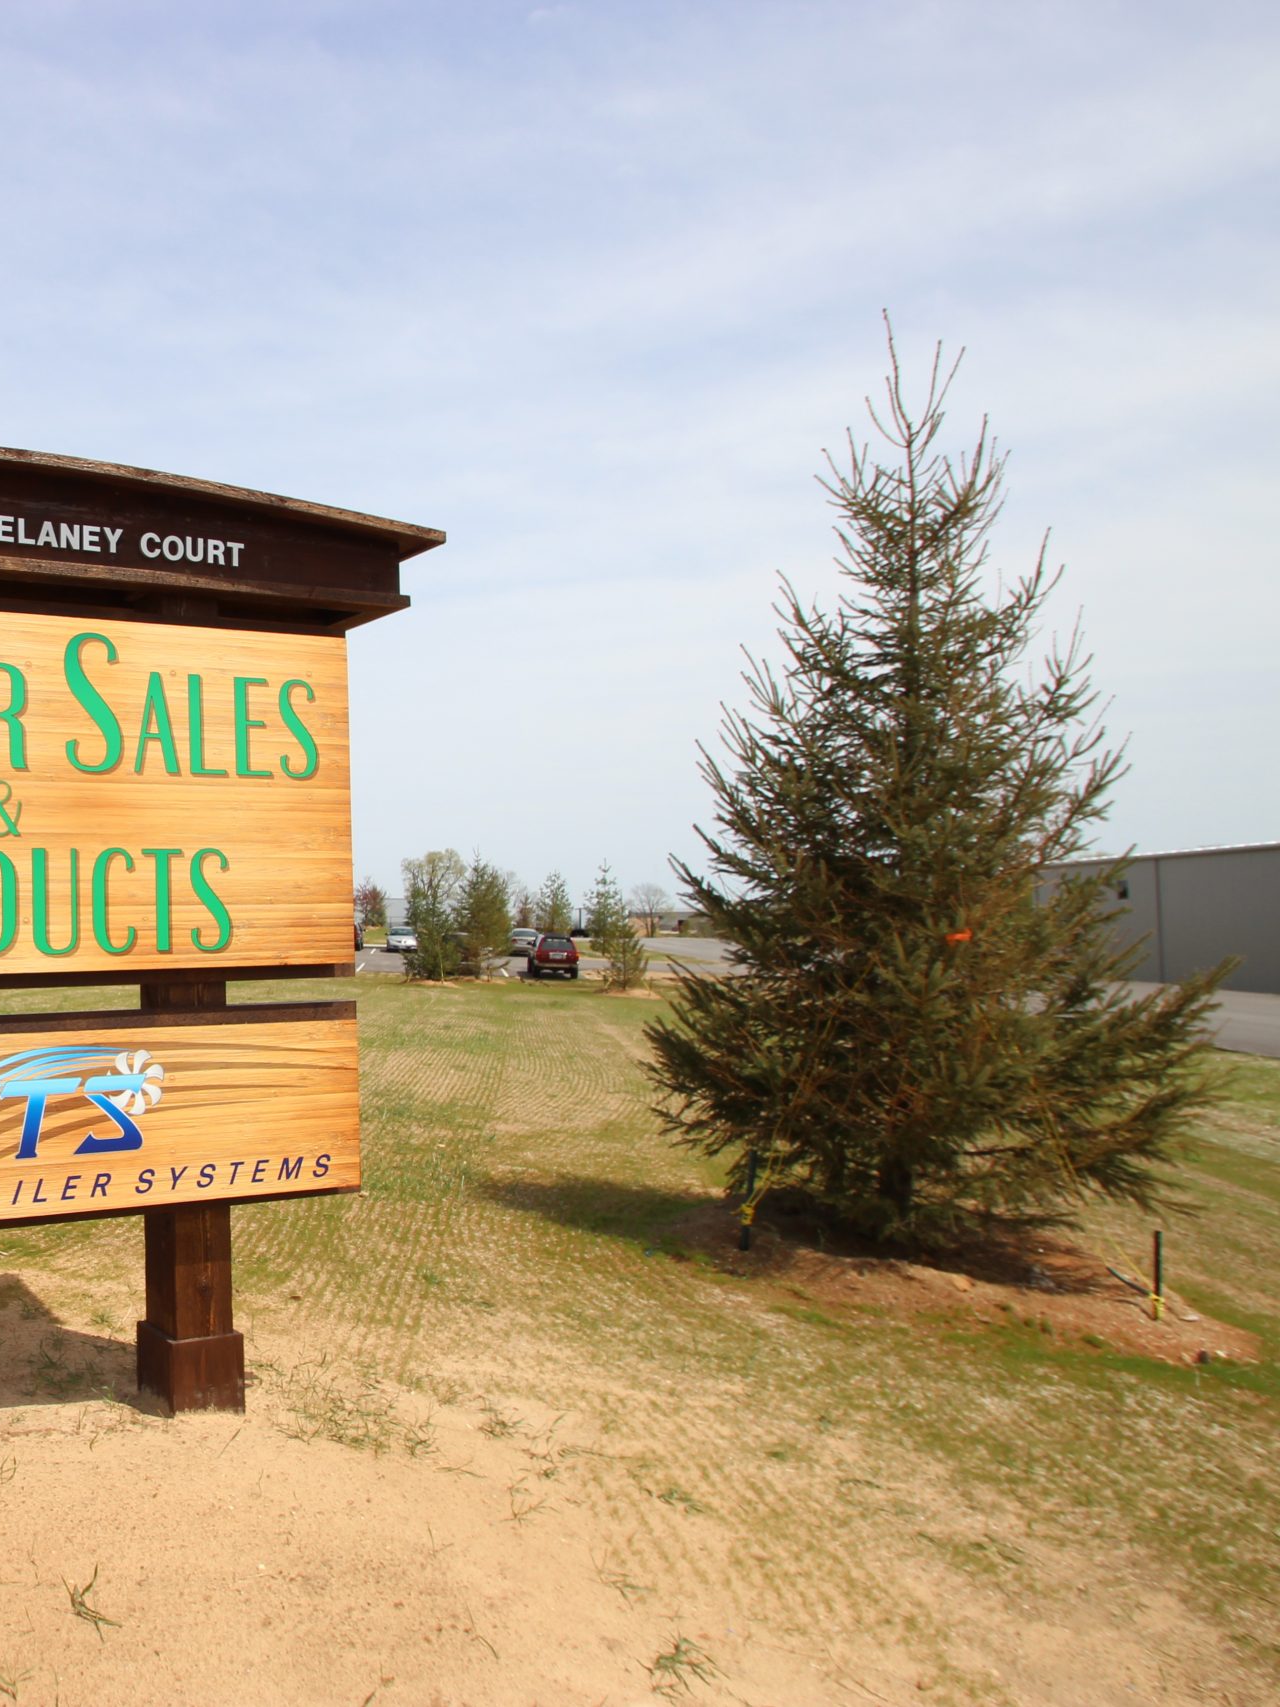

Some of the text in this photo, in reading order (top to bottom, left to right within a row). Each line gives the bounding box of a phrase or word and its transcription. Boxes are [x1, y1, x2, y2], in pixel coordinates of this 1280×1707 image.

[140, 532, 245, 567] COURT
[63, 632, 320, 780] SALES
[134, 1152, 334, 1194] SYSTEMS
